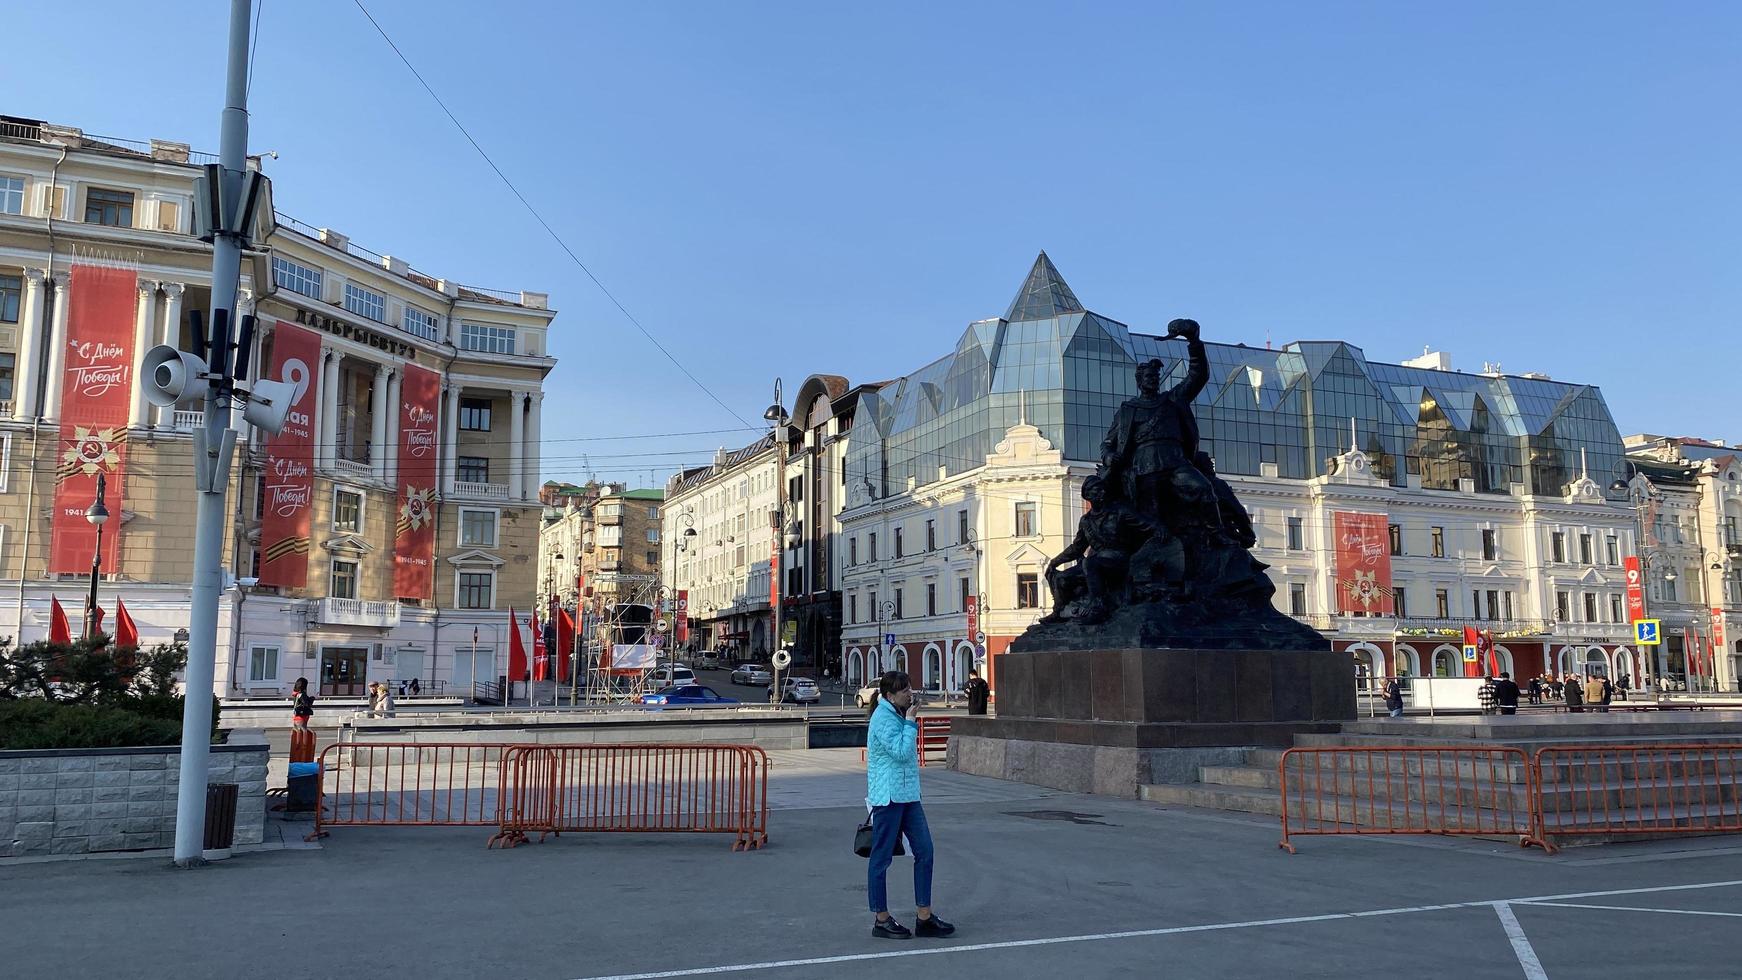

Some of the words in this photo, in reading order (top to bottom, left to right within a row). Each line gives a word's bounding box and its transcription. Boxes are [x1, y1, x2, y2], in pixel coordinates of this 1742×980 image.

[296, 309, 416, 360] ДАЛЬРЫБВТУЗ
[78, 342, 92, 359] С
[89, 343, 124, 365] Днём
[67, 364, 129, 397] Победы!
[281, 358, 310, 407] 9
[409, 406, 417, 422] С
[282, 426, 309, 439] 41-1945
[275, 458, 285, 476] С
[282, 460, 307, 483] Днём
[267, 484, 311, 518] Победы!
[64, 508, 84, 516] 1941
[1627, 570, 1638, 583] 9
[679, 599, 687, 610] 9
[968, 604, 975, 614] 9
[1713, 614, 1721, 623] 9
